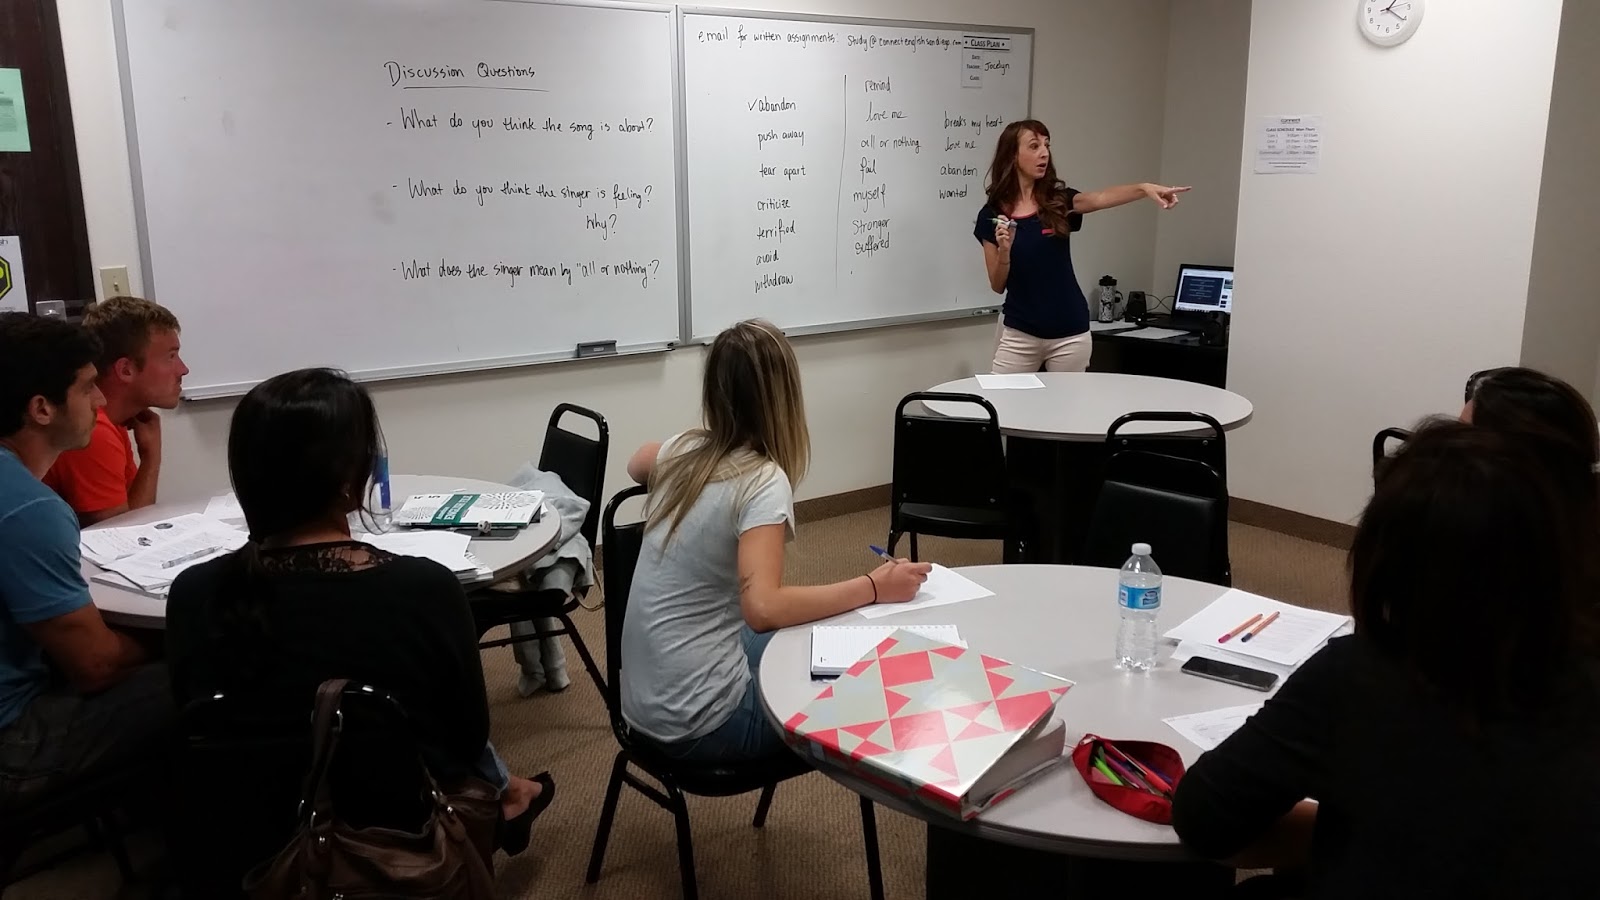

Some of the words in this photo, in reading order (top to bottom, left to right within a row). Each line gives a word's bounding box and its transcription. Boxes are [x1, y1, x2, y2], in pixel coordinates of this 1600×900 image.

[738, 24, 748, 48] for
[754, 32, 781, 41] written
[971, 39, 985, 47] CLASS
[384, 61, 464, 86] Discussion
[477, 62, 535, 77] Questions
[985, 60, 1009, 75] Jocelyn
[865, 76, 890, 92] remind
[759, 96, 796, 112] abandon
[866, 102, 888, 122] love
[892, 111, 907, 119] me
[401, 107, 437, 129] What
[450, 113, 462, 127] do
[472, 119, 493, 138] you
[503, 117, 536, 130] think
[543, 118, 562, 132] the
[570, 123, 594, 140] song
[601, 123, 610, 131] is
[619, 118, 653, 132] about?
[972, 120, 981, 135] my
[985, 115, 1003, 128] heart
[758, 130, 778, 150] push
[782, 131, 804, 146] away
[861, 139, 874, 147] all
[894, 136, 921, 154] nothing
[965, 141, 976, 149] me
[759, 164, 776, 177] tear
[784, 166, 806, 180] apart
[860, 157, 876, 184] fail
[941, 164, 977, 176] abandon
[409, 178, 443, 198] What
[453, 180, 467, 195] do
[476, 186, 493, 206] you
[501, 181, 531, 195] think
[536, 184, 556, 197] the
[561, 186, 590, 207] singer
[598, 186, 606, 199] is
[613, 184, 652, 208] feeling?
[853, 184, 885, 213] myself
[758, 198, 790, 211] criticize
[757, 219, 795, 243] terrified
[757, 250, 779, 265] avoid
[402, 259, 430, 280] What
[439, 259, 461, 277] does
[466, 264, 488, 278] the
[494, 265, 523, 287] singer
[530, 265, 556, 277] mean
[561, 263, 571, 285] by
[601, 264, 610, 276] or
[755, 273, 793, 293] withdraw
